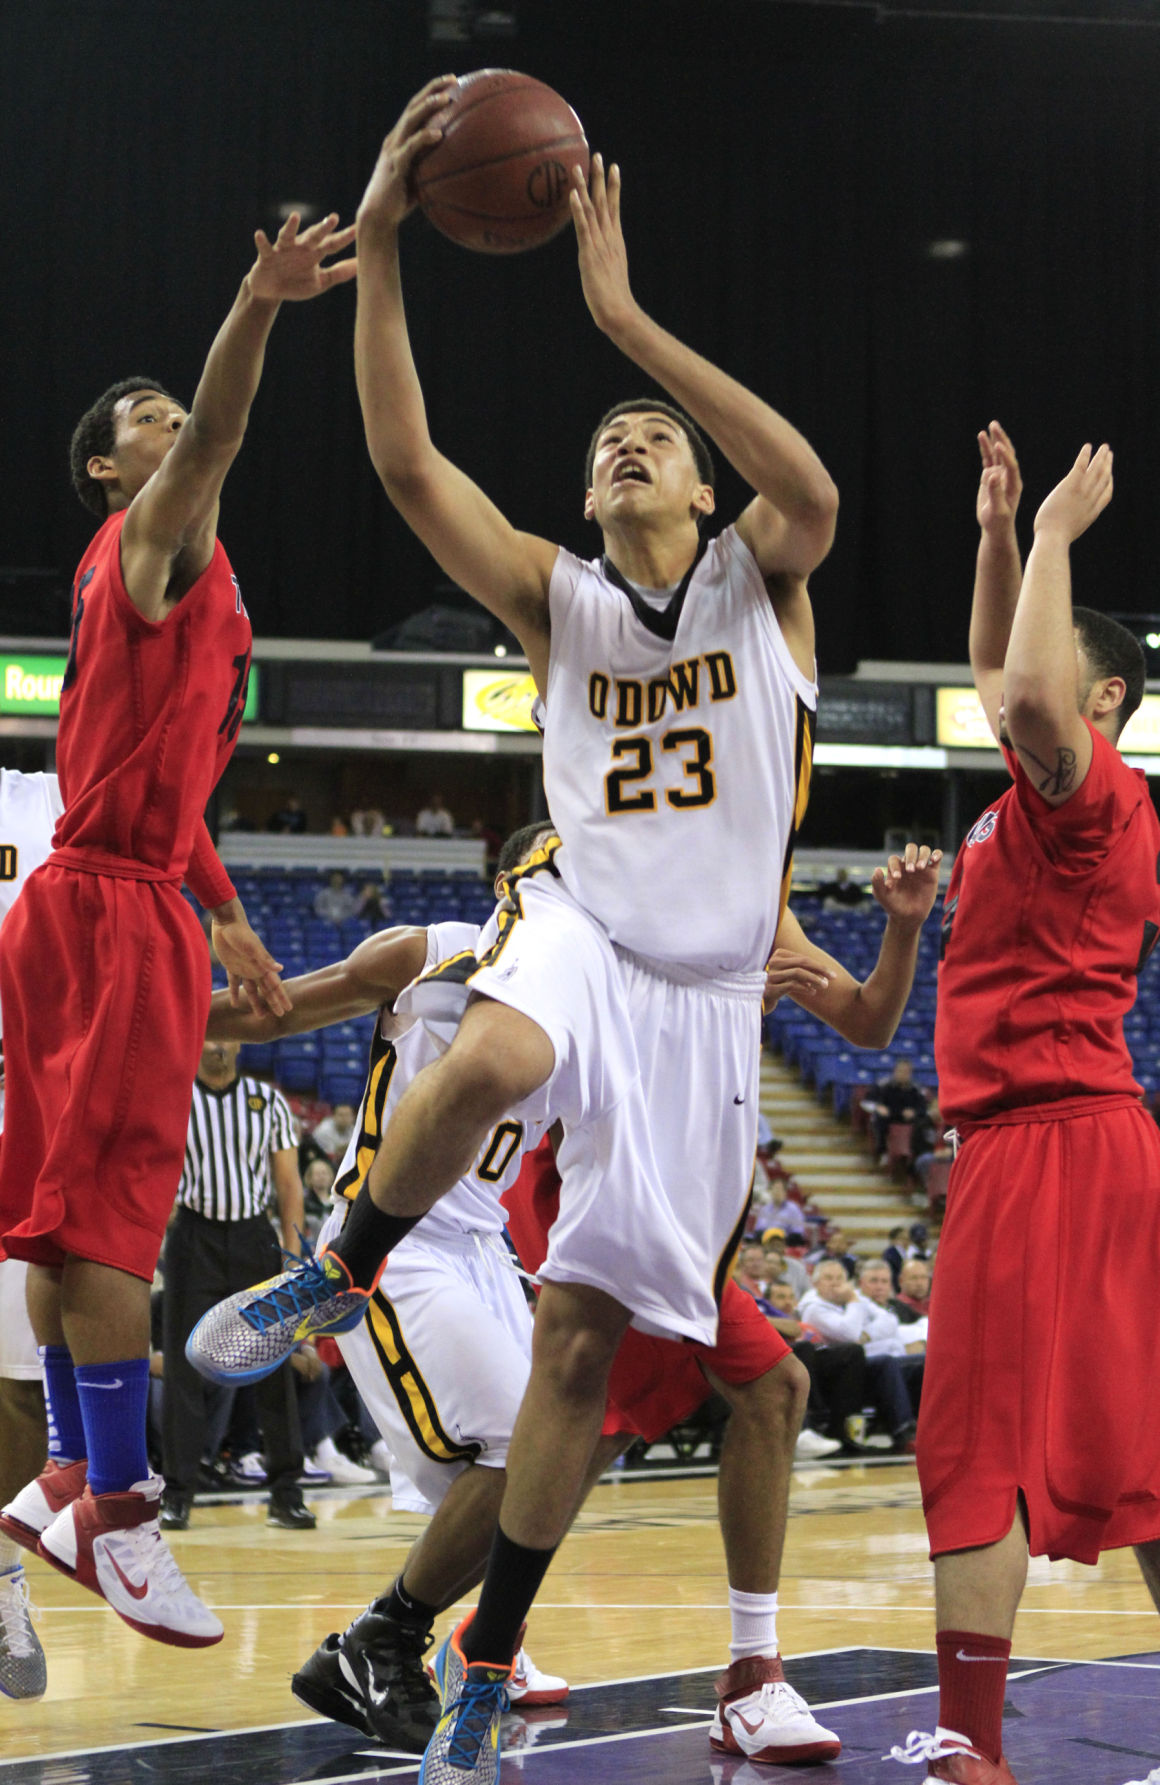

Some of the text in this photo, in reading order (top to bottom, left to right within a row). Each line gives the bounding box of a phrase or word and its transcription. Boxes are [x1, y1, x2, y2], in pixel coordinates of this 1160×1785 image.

[588, 649, 738, 729] ODOWD
[604, 726, 717, 816] 23
[465, 1119, 524, 1184] 0
